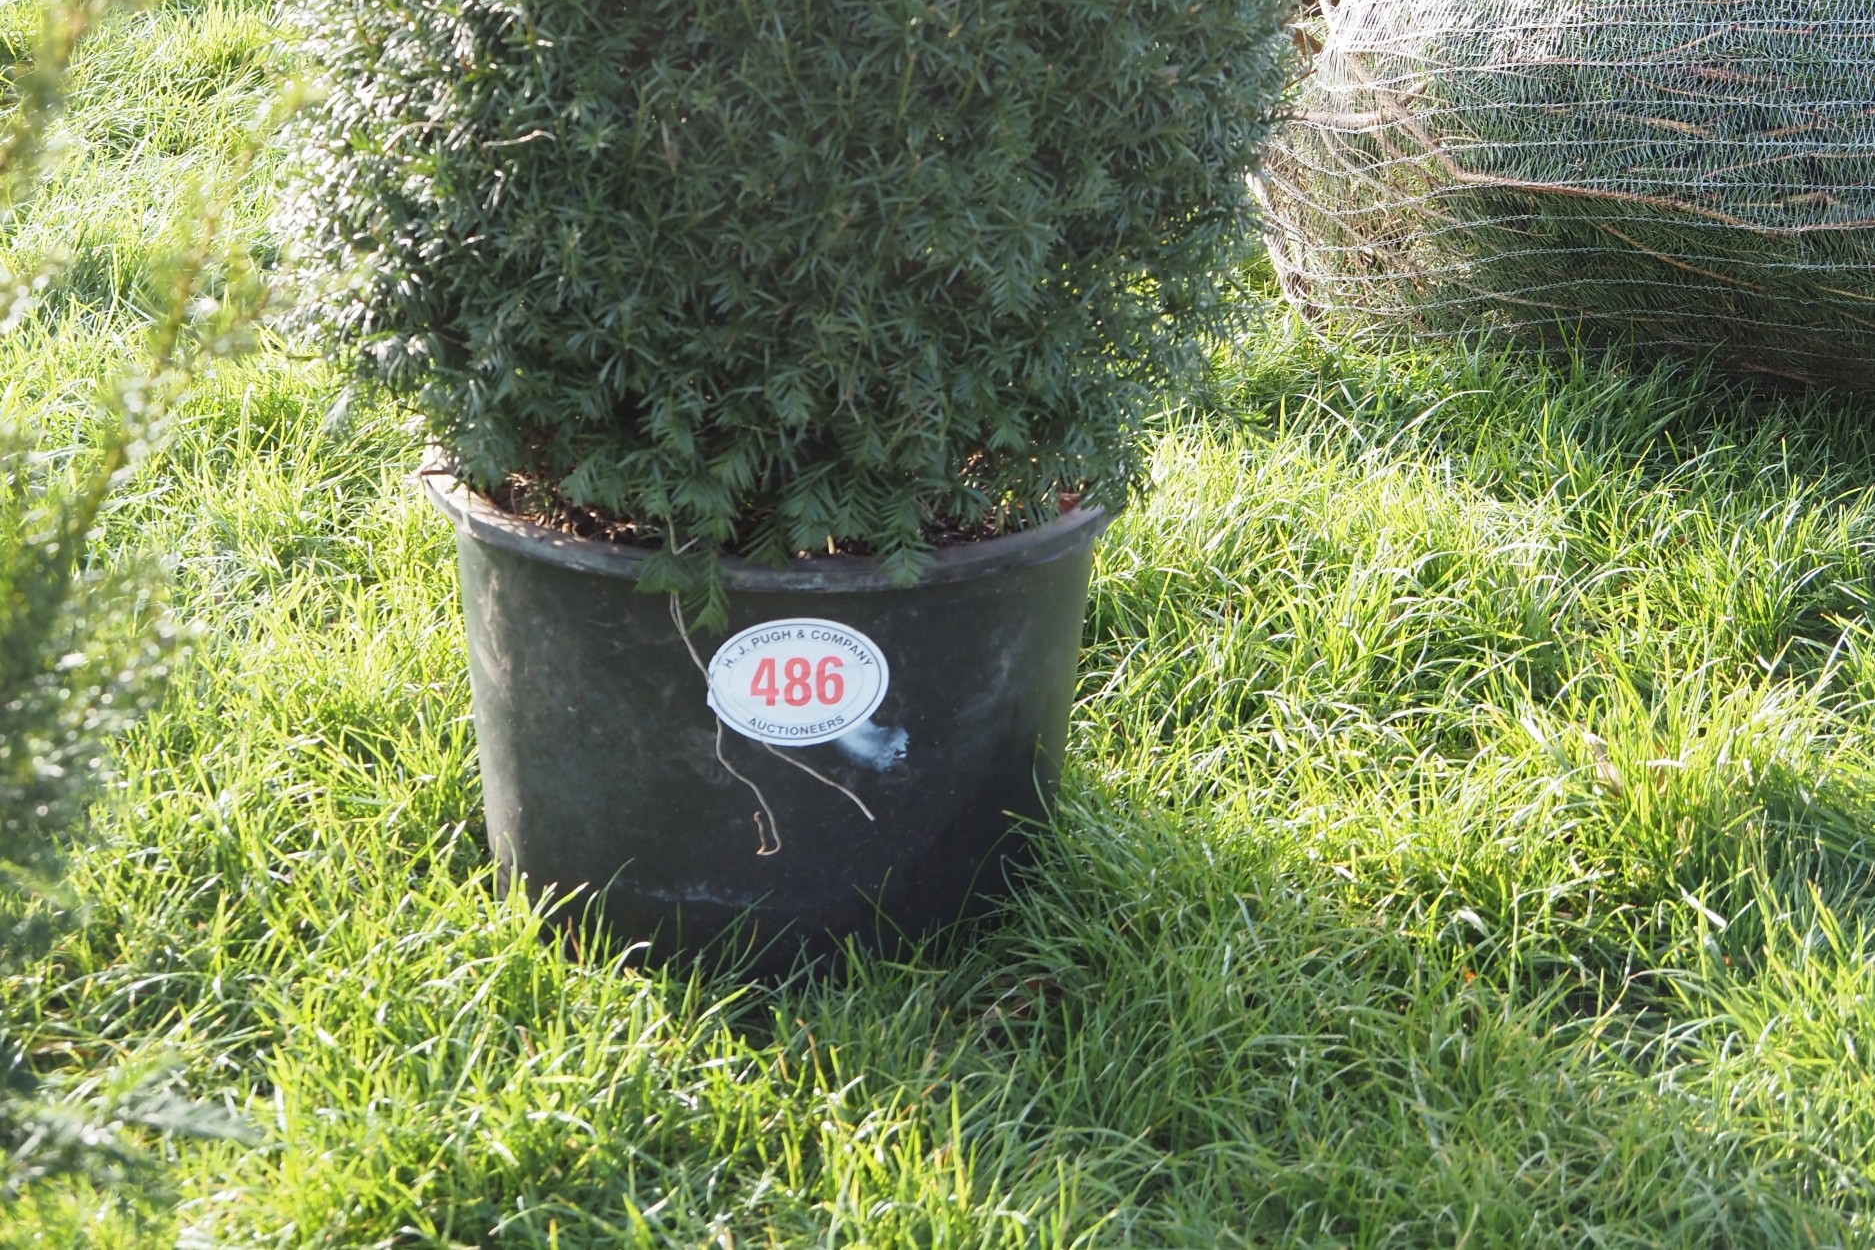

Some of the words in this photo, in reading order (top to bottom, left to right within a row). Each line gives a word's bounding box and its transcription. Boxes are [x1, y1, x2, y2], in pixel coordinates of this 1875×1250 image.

[723, 658, 737, 669] H.
[738, 645, 750, 656] J.
[751, 630, 791, 647] PUGH
[797, 629, 805, 639] &
[811, 630, 873, 667] COMPANY
[750, 656, 844, 707] 486
[748, 715, 845, 736] AUCTIONEERS
